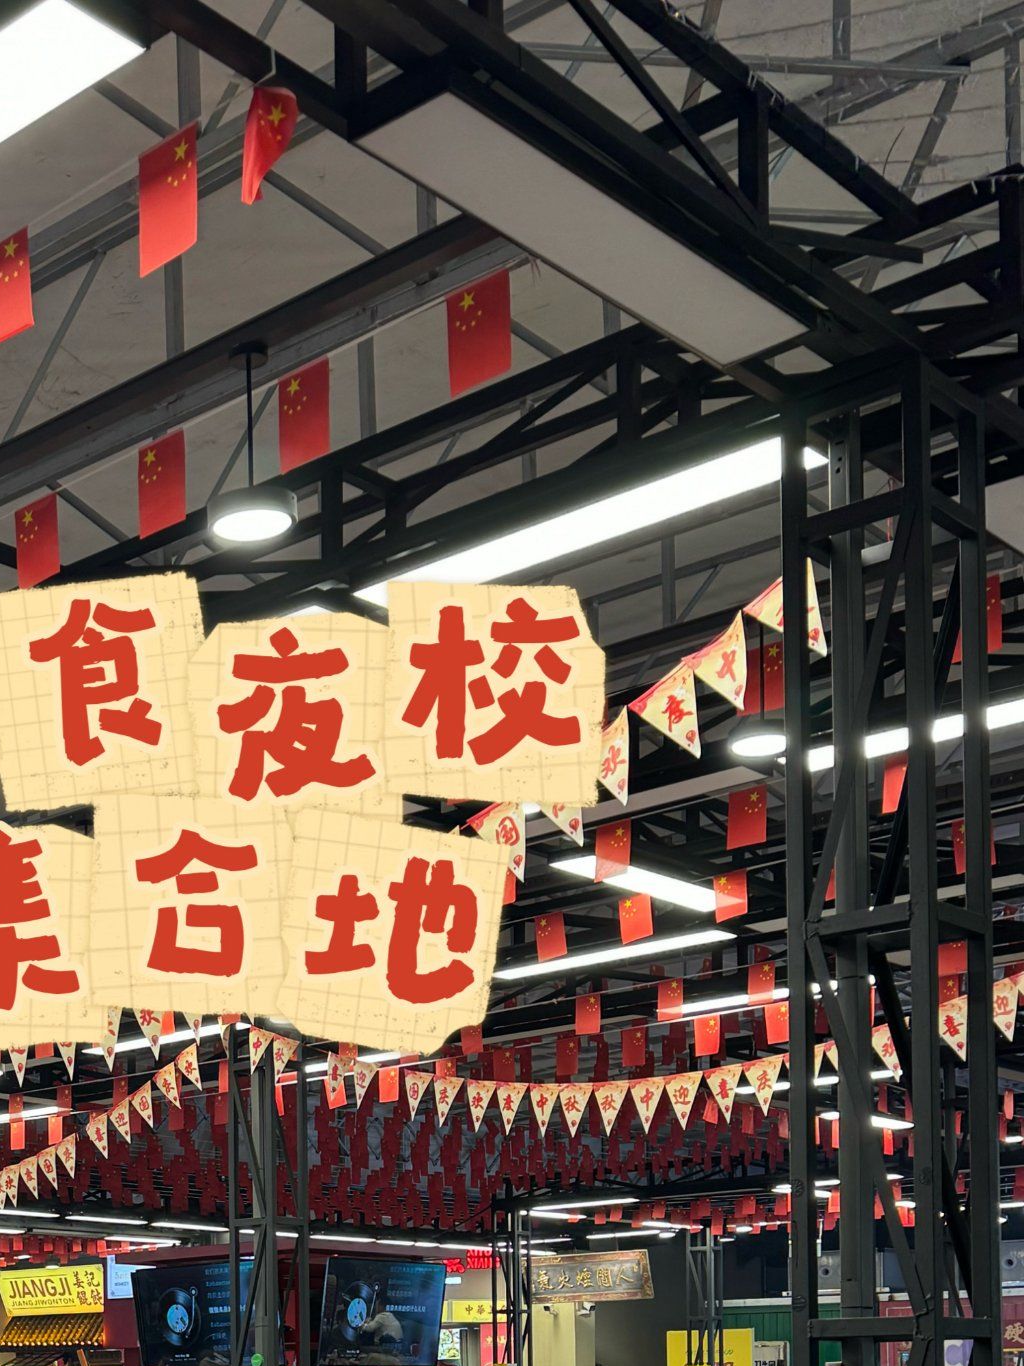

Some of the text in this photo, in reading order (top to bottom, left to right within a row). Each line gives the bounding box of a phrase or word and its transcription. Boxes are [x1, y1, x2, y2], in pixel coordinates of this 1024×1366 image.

[942, 1015, 963, 1037] 喜
[673, 1085, 691, 1105] 迎
[716, 1078, 733, 1099] 喜
[536, 1093, 549, 1116] 中
[563, 1095, 581, 1113] 秋
[600, 1094, 618, 1112] 秋
[640, 1088, 654, 1111] 中
[9, 1276, 72, 1299] JIANGJI
